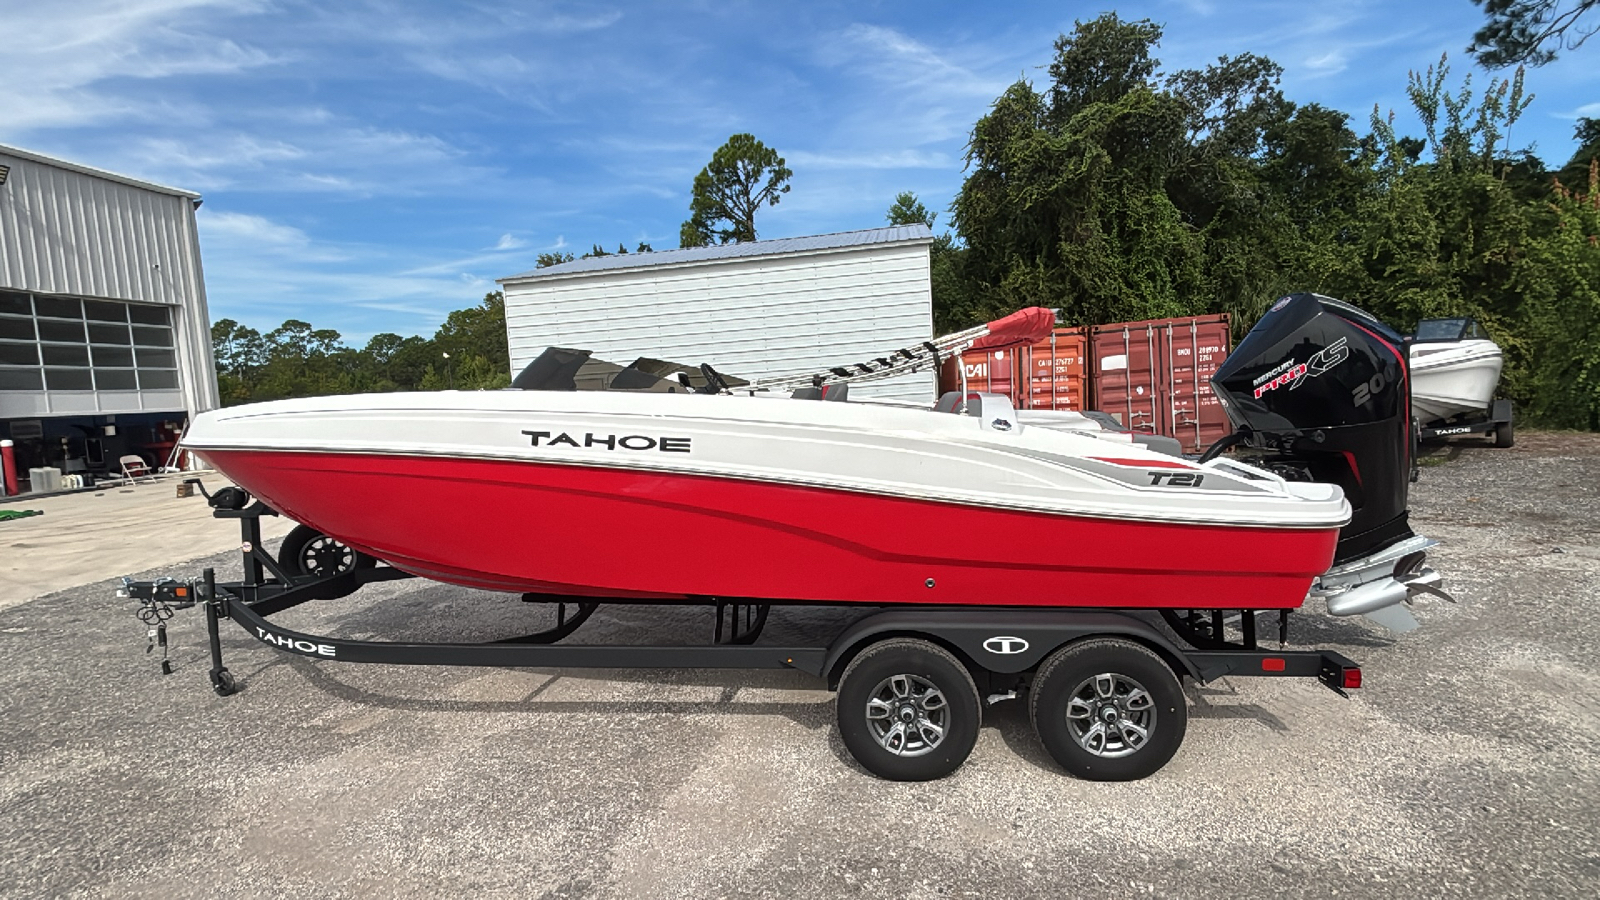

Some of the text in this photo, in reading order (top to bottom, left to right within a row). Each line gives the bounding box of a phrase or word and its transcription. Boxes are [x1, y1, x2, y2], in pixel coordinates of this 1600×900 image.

[1221, 344, 1226, 352] 6
[965, 363, 987, 377] CAI
[1253, 358, 1295, 386] MERCURY
[1352, 366, 1395, 407] 200
[1435, 427, 1471, 435] TAHOE
[521, 430, 691, 453] TAHOE
[1147, 471, 1204, 487] T21
[256, 626, 336, 656] TAHOE
